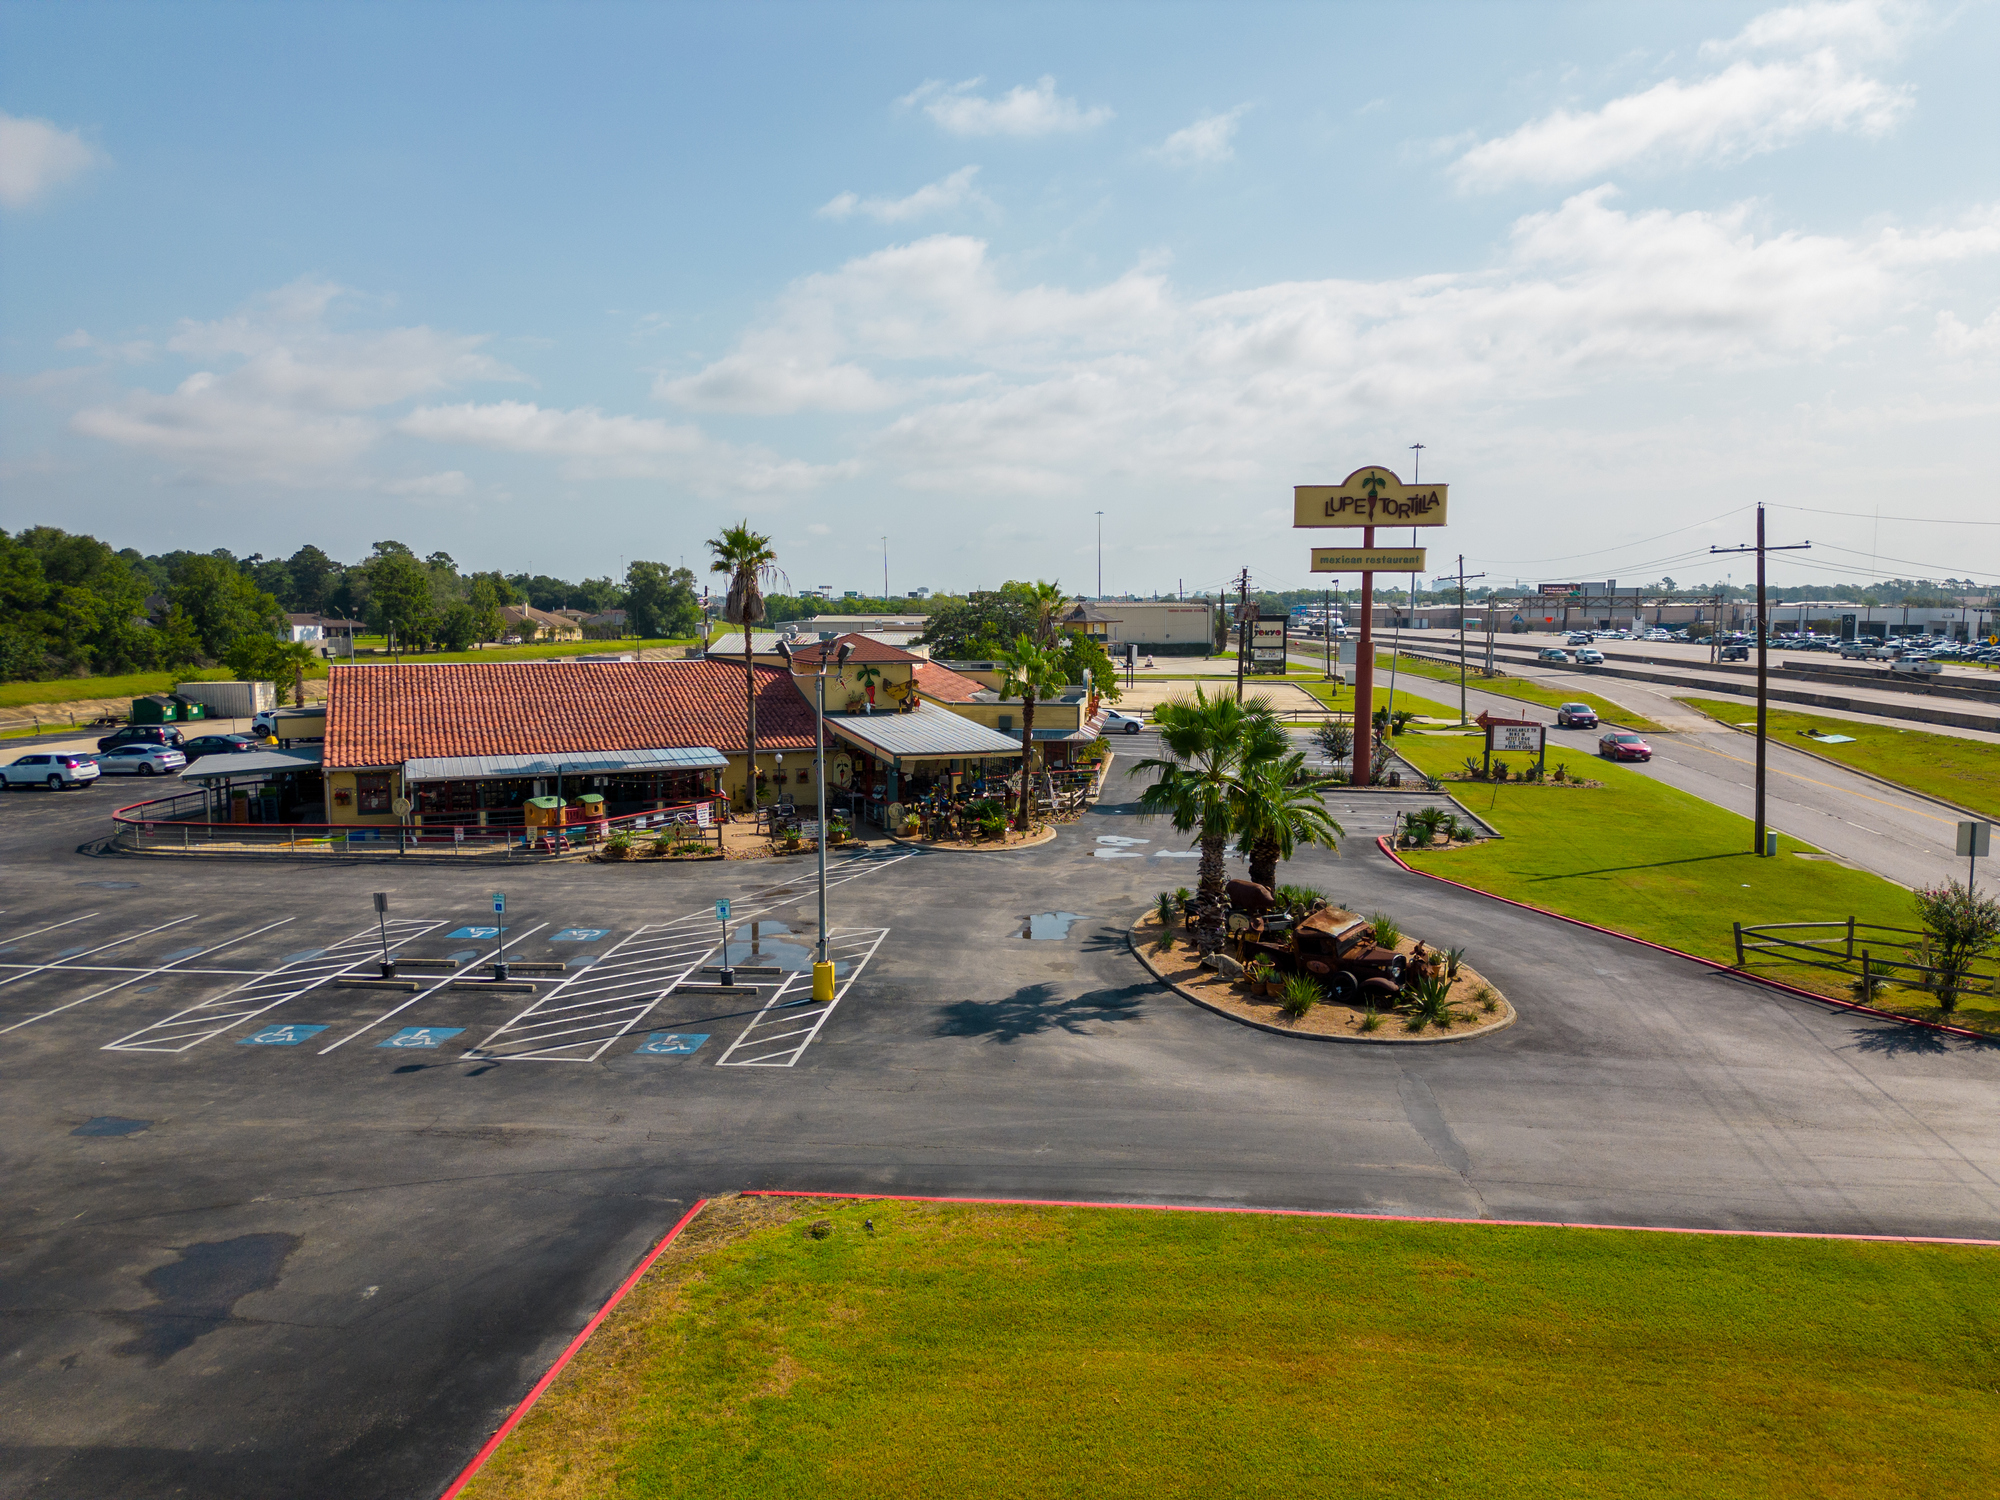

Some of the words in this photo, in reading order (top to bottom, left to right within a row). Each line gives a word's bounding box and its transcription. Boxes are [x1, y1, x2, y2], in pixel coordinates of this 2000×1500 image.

[1325, 496, 1366, 517] LUPE
[1320, 555, 1362, 564] mexican
[1365, 555, 1420, 564] restaurant
